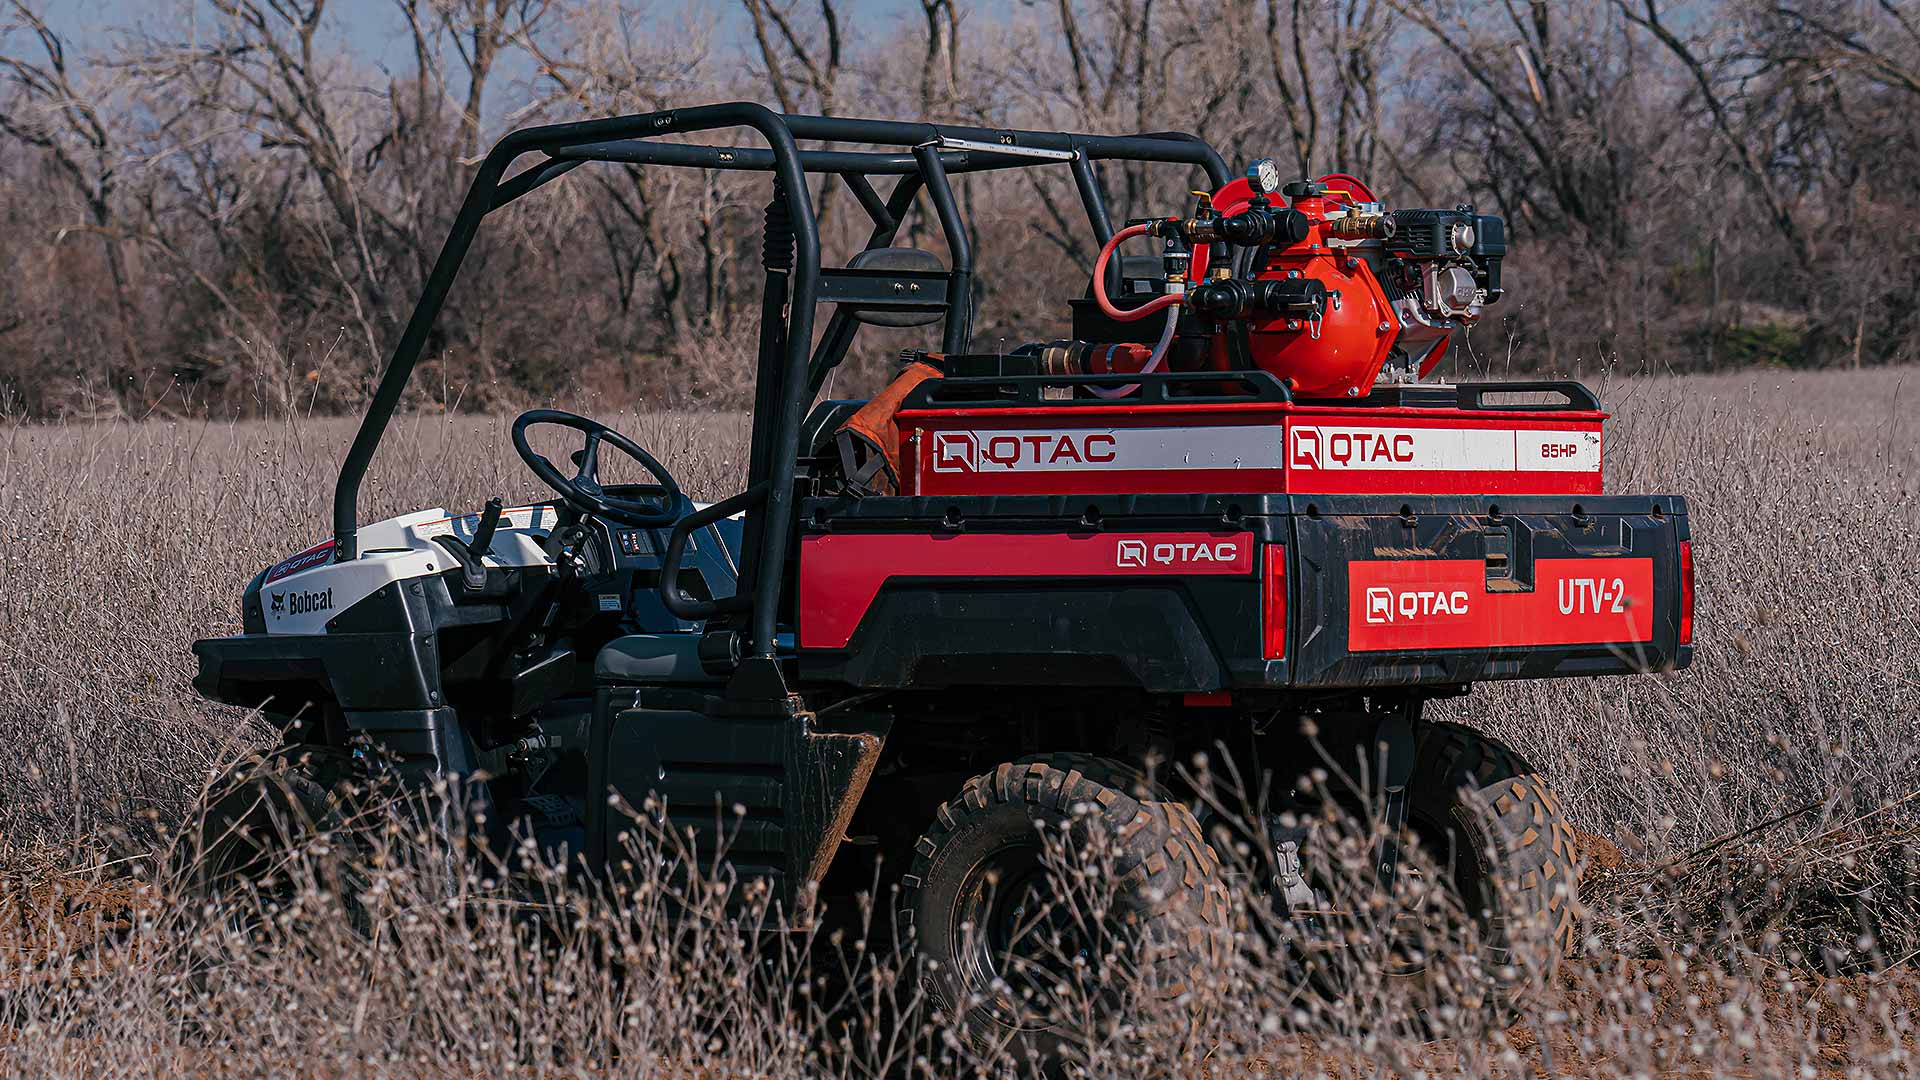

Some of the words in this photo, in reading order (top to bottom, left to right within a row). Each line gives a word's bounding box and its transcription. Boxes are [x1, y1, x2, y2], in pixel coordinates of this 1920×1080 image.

[988, 434, 1117, 468] QTAC
[1330, 433, 1414, 467] QTAC
[1541, 443, 1577, 458] 85HP
[1153, 542, 1237, 565] QTAC
[289, 587, 334, 616] Bobcat
[1398, 591, 1469, 620] QTAC
[1557, 577, 1625, 615] UTV-2
